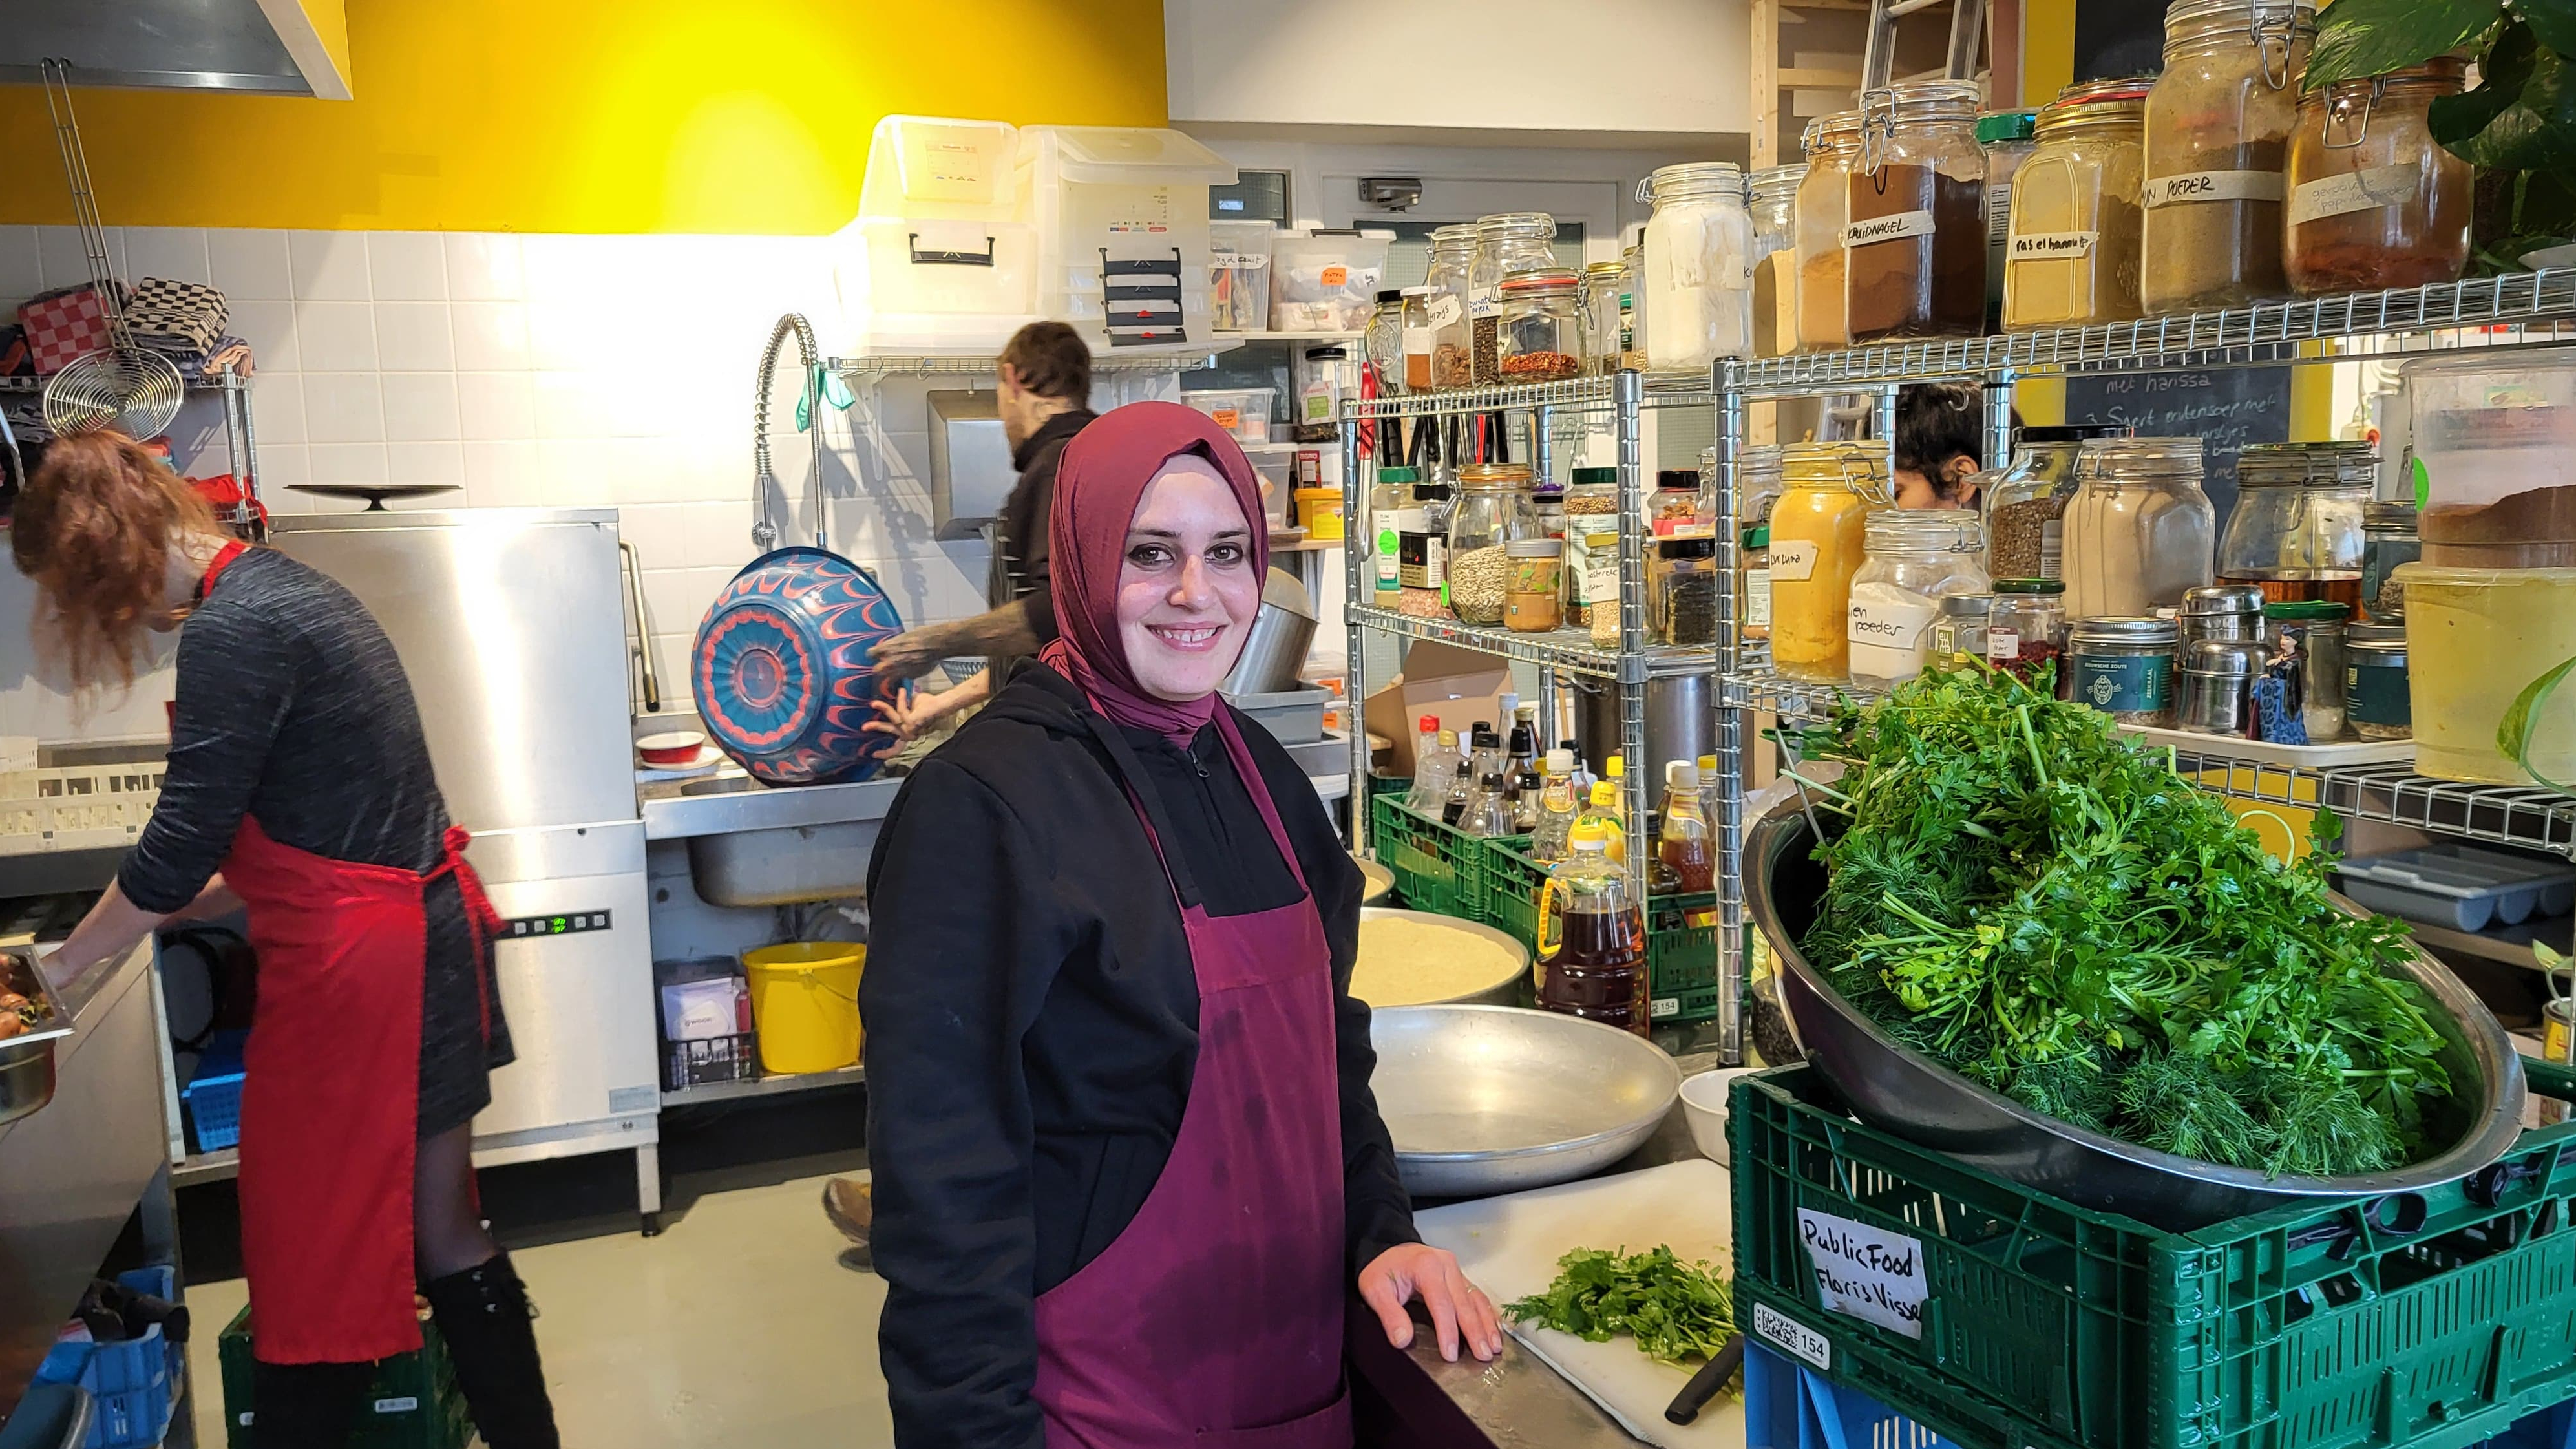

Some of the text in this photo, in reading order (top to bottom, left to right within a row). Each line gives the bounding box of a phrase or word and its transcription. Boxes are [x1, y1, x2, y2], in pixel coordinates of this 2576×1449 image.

[2167, 176, 2215, 199] POEDER
[2016, 239, 2033, 252] ras
[2107, 374, 2212, 394] met harissa
[1855, 620, 1906, 637] poeder
[1661, 1002, 1674, 1010] 154
[1815, 1265, 1921, 1320] Floris Visse
[1802, 1334, 1824, 1357] 154
